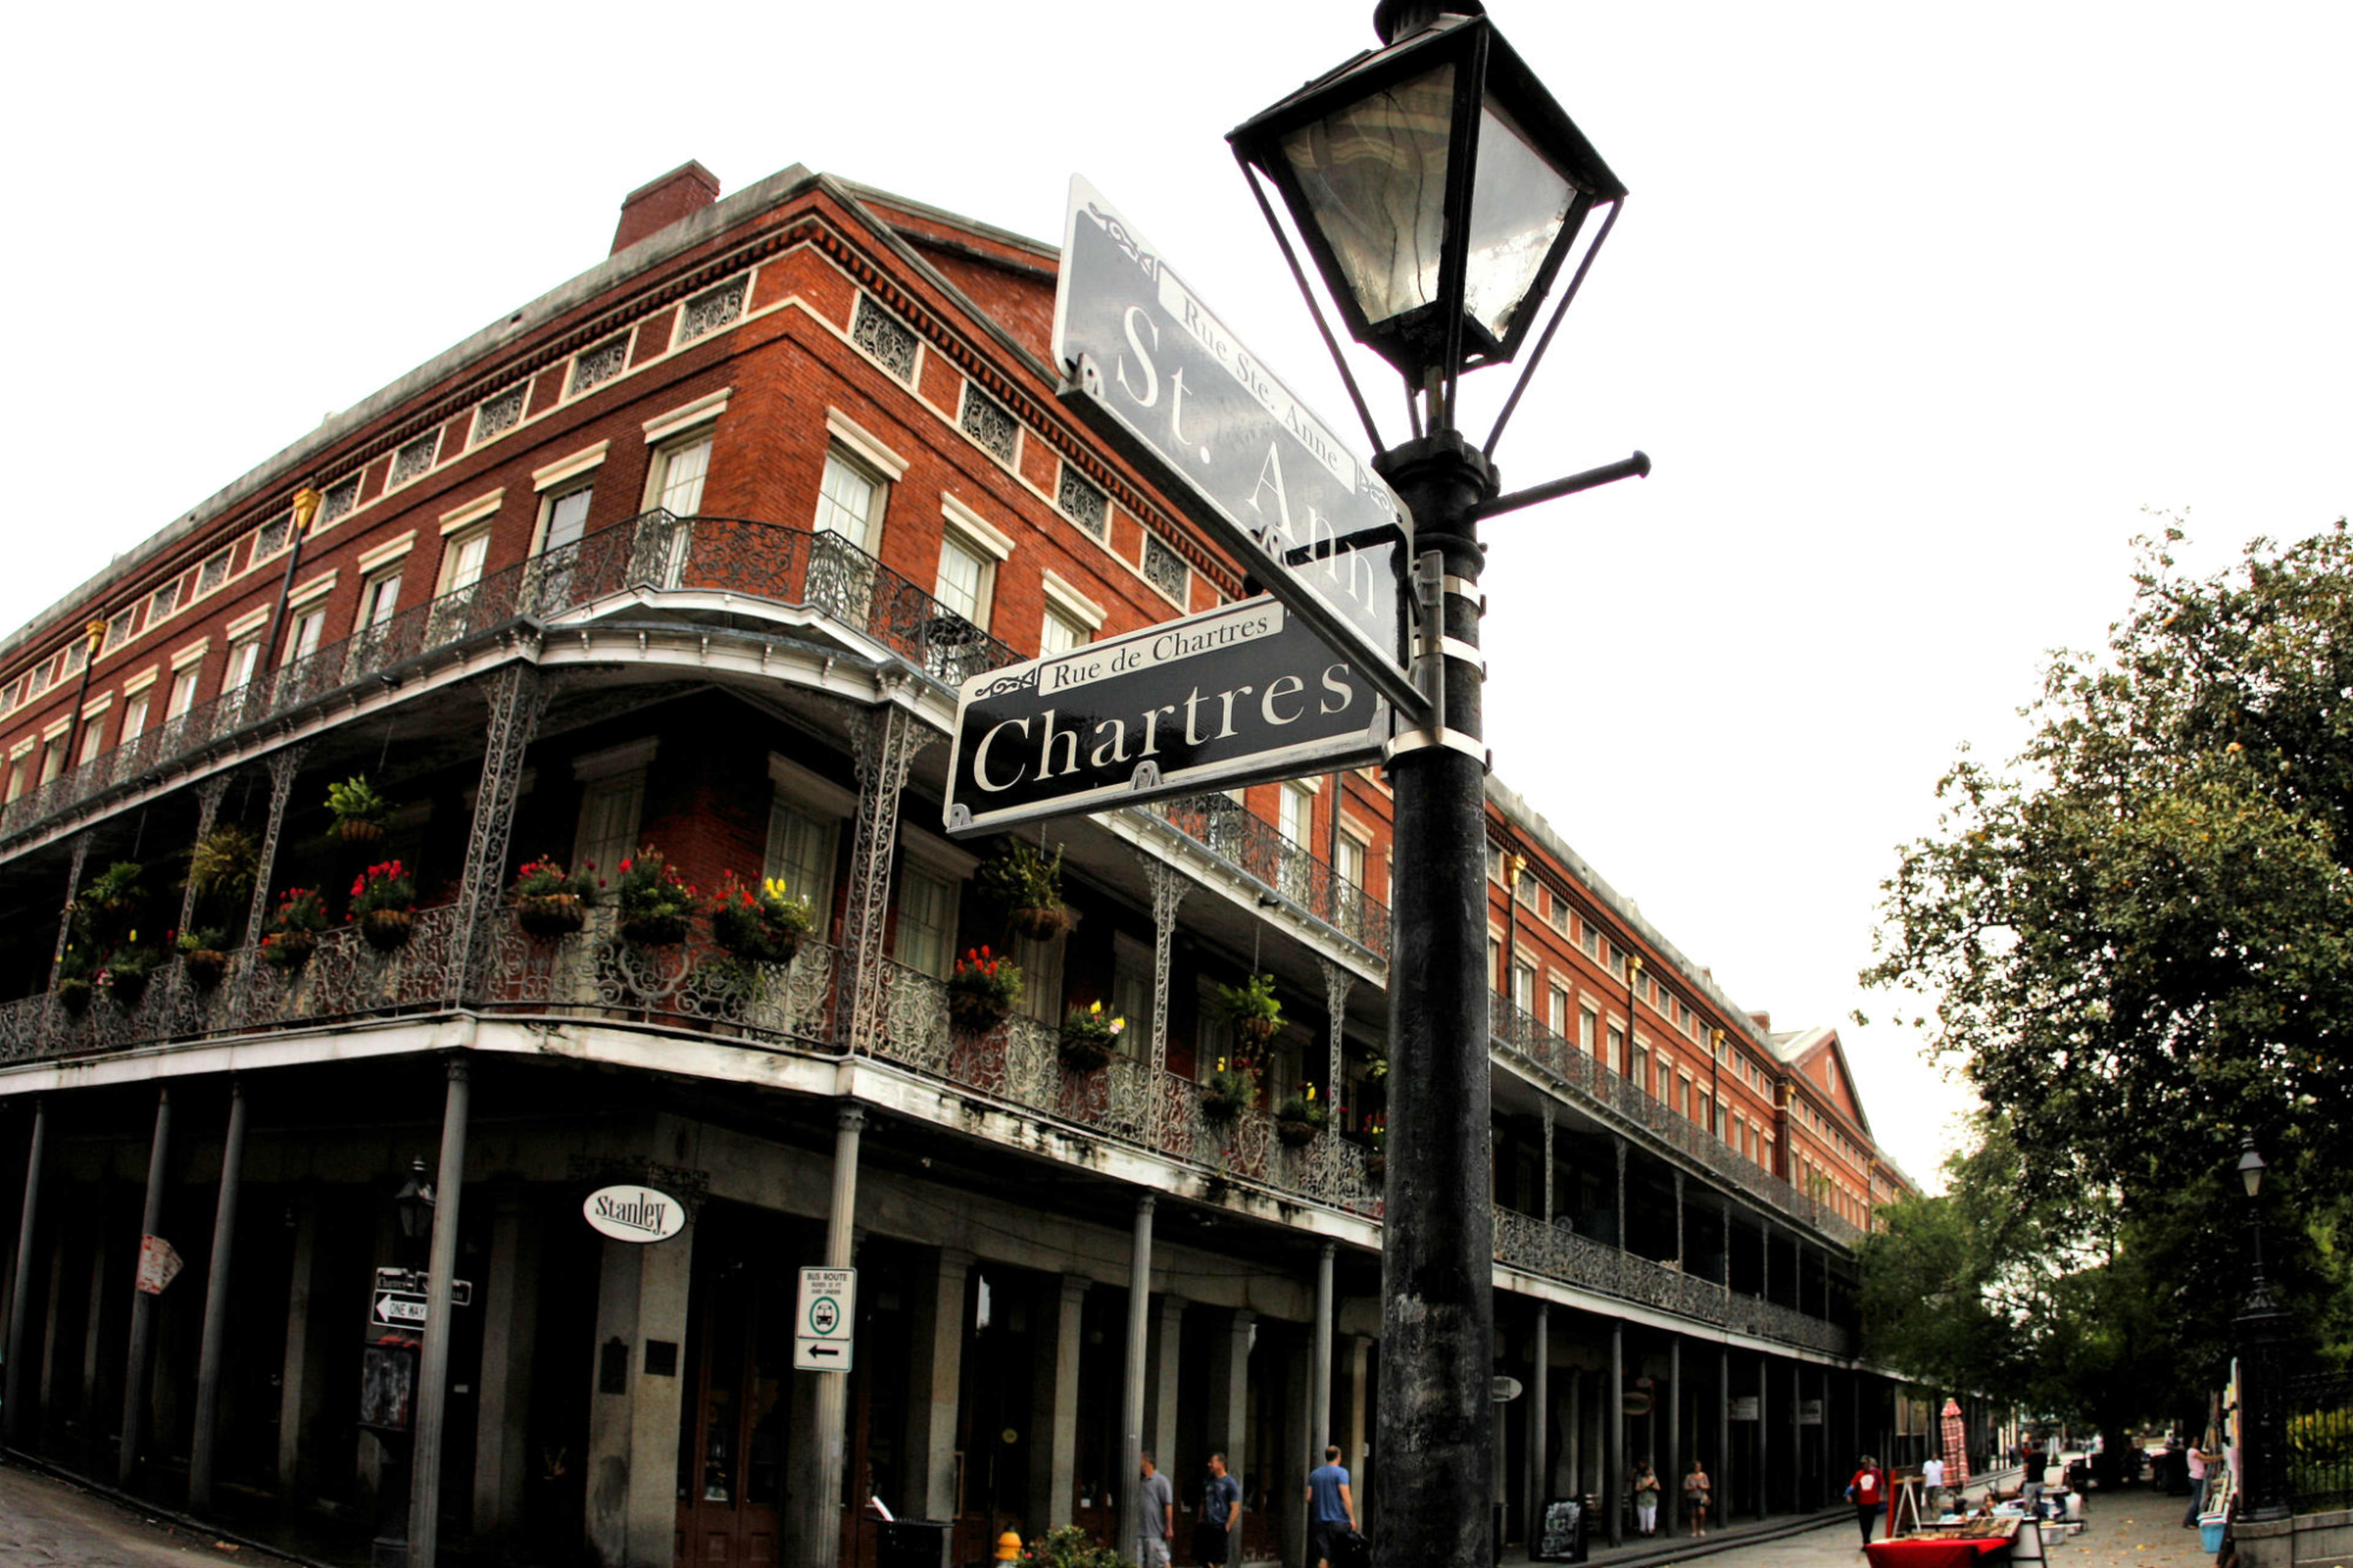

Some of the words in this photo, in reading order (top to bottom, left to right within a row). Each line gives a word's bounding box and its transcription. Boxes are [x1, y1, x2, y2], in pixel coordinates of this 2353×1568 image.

[1183, 294, 1229, 362] Rue
[1236, 351, 1276, 411] Ste.
[1284, 403, 1338, 472] Anne
[1116, 305, 1211, 464] St.
[1245, 440, 1378, 620] Ann
[1052, 662, 1102, 689] Rue
[1111, 647, 1142, 673] de
[1152, 613, 1268, 662] Chartres
[974, 662, 1353, 793] Chartres
[390, 1302, 406, 1316] ONE
[408, 1304, 425, 1317] WAY
